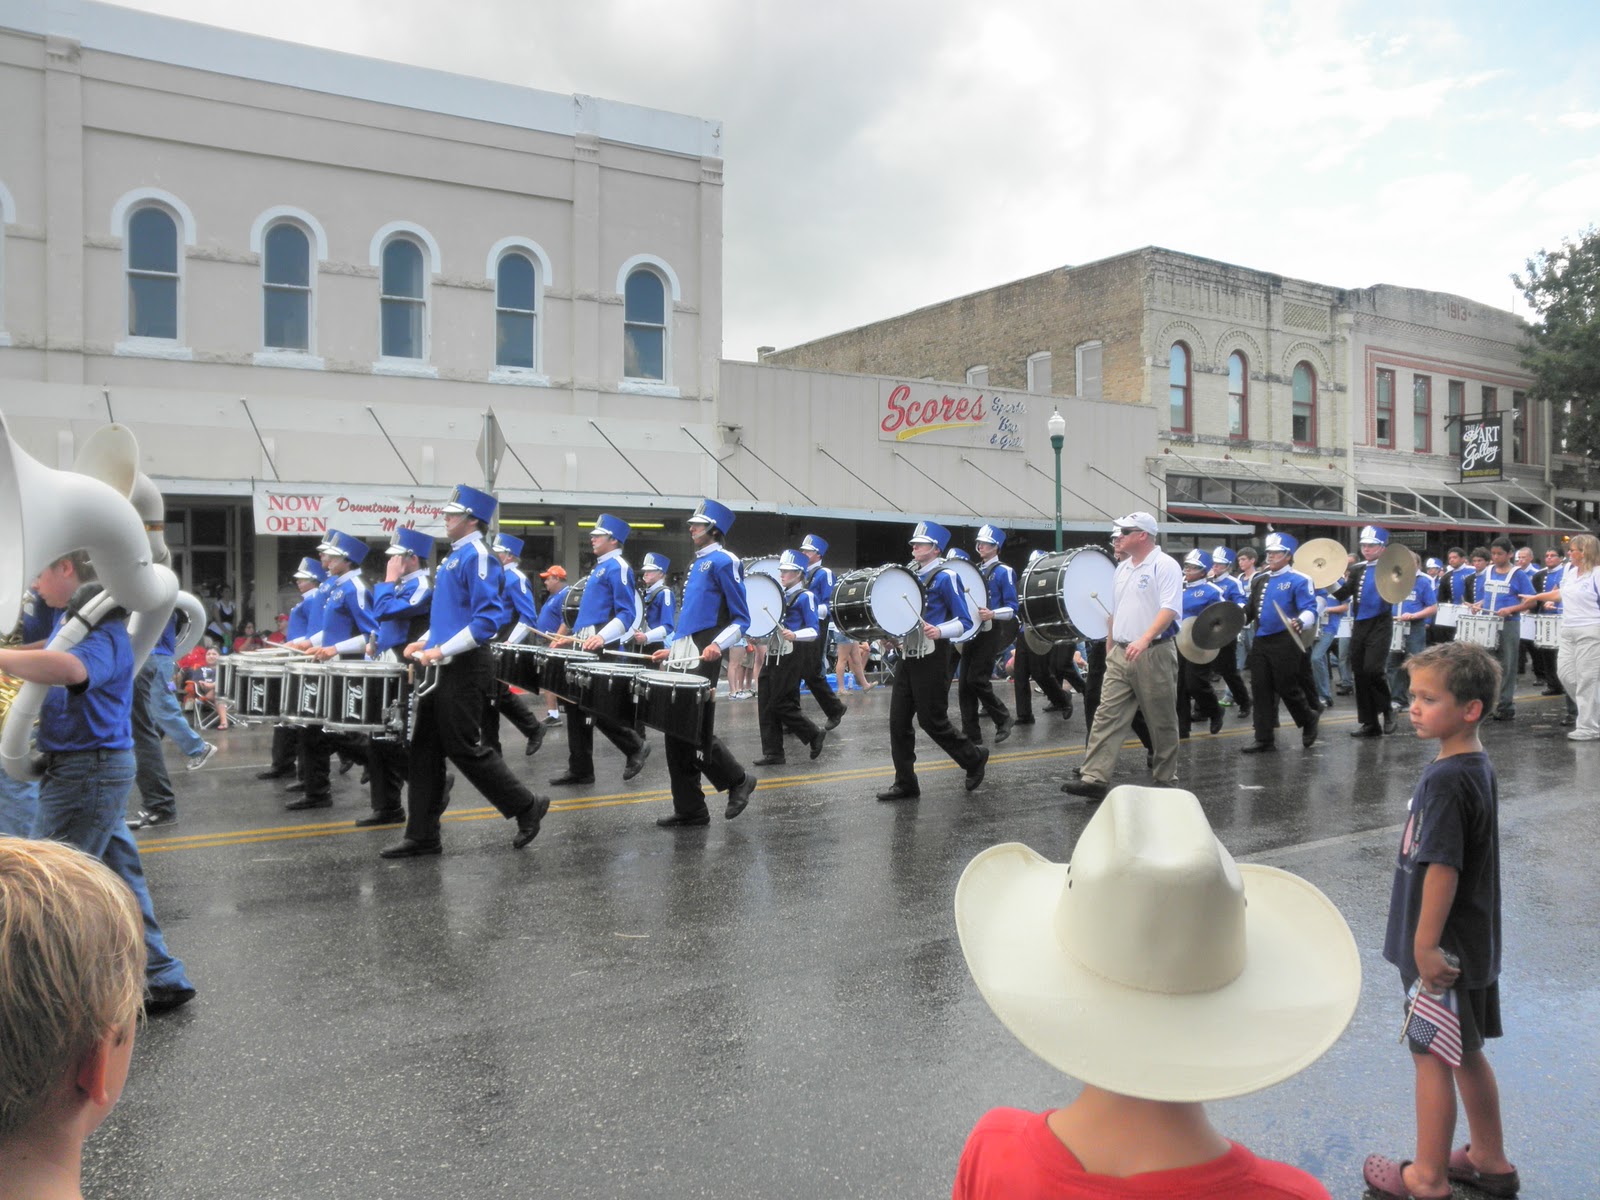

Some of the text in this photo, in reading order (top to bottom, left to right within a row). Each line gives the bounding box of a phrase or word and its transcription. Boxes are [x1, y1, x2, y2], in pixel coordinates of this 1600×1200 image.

[881, 384, 987, 431] Scores
[1478, 426, 1500, 442] ART
[1462, 442, 1500, 469] Gallery
[268, 495, 323, 511] NOW
[336, 497, 445, 519] Downtown Antiqu
[266, 516, 328, 532] OPEN
[252, 678, 265, 713] Pearl
[303, 677, 318, 714] Pearl
[348, 680, 363, 720] Pearl
